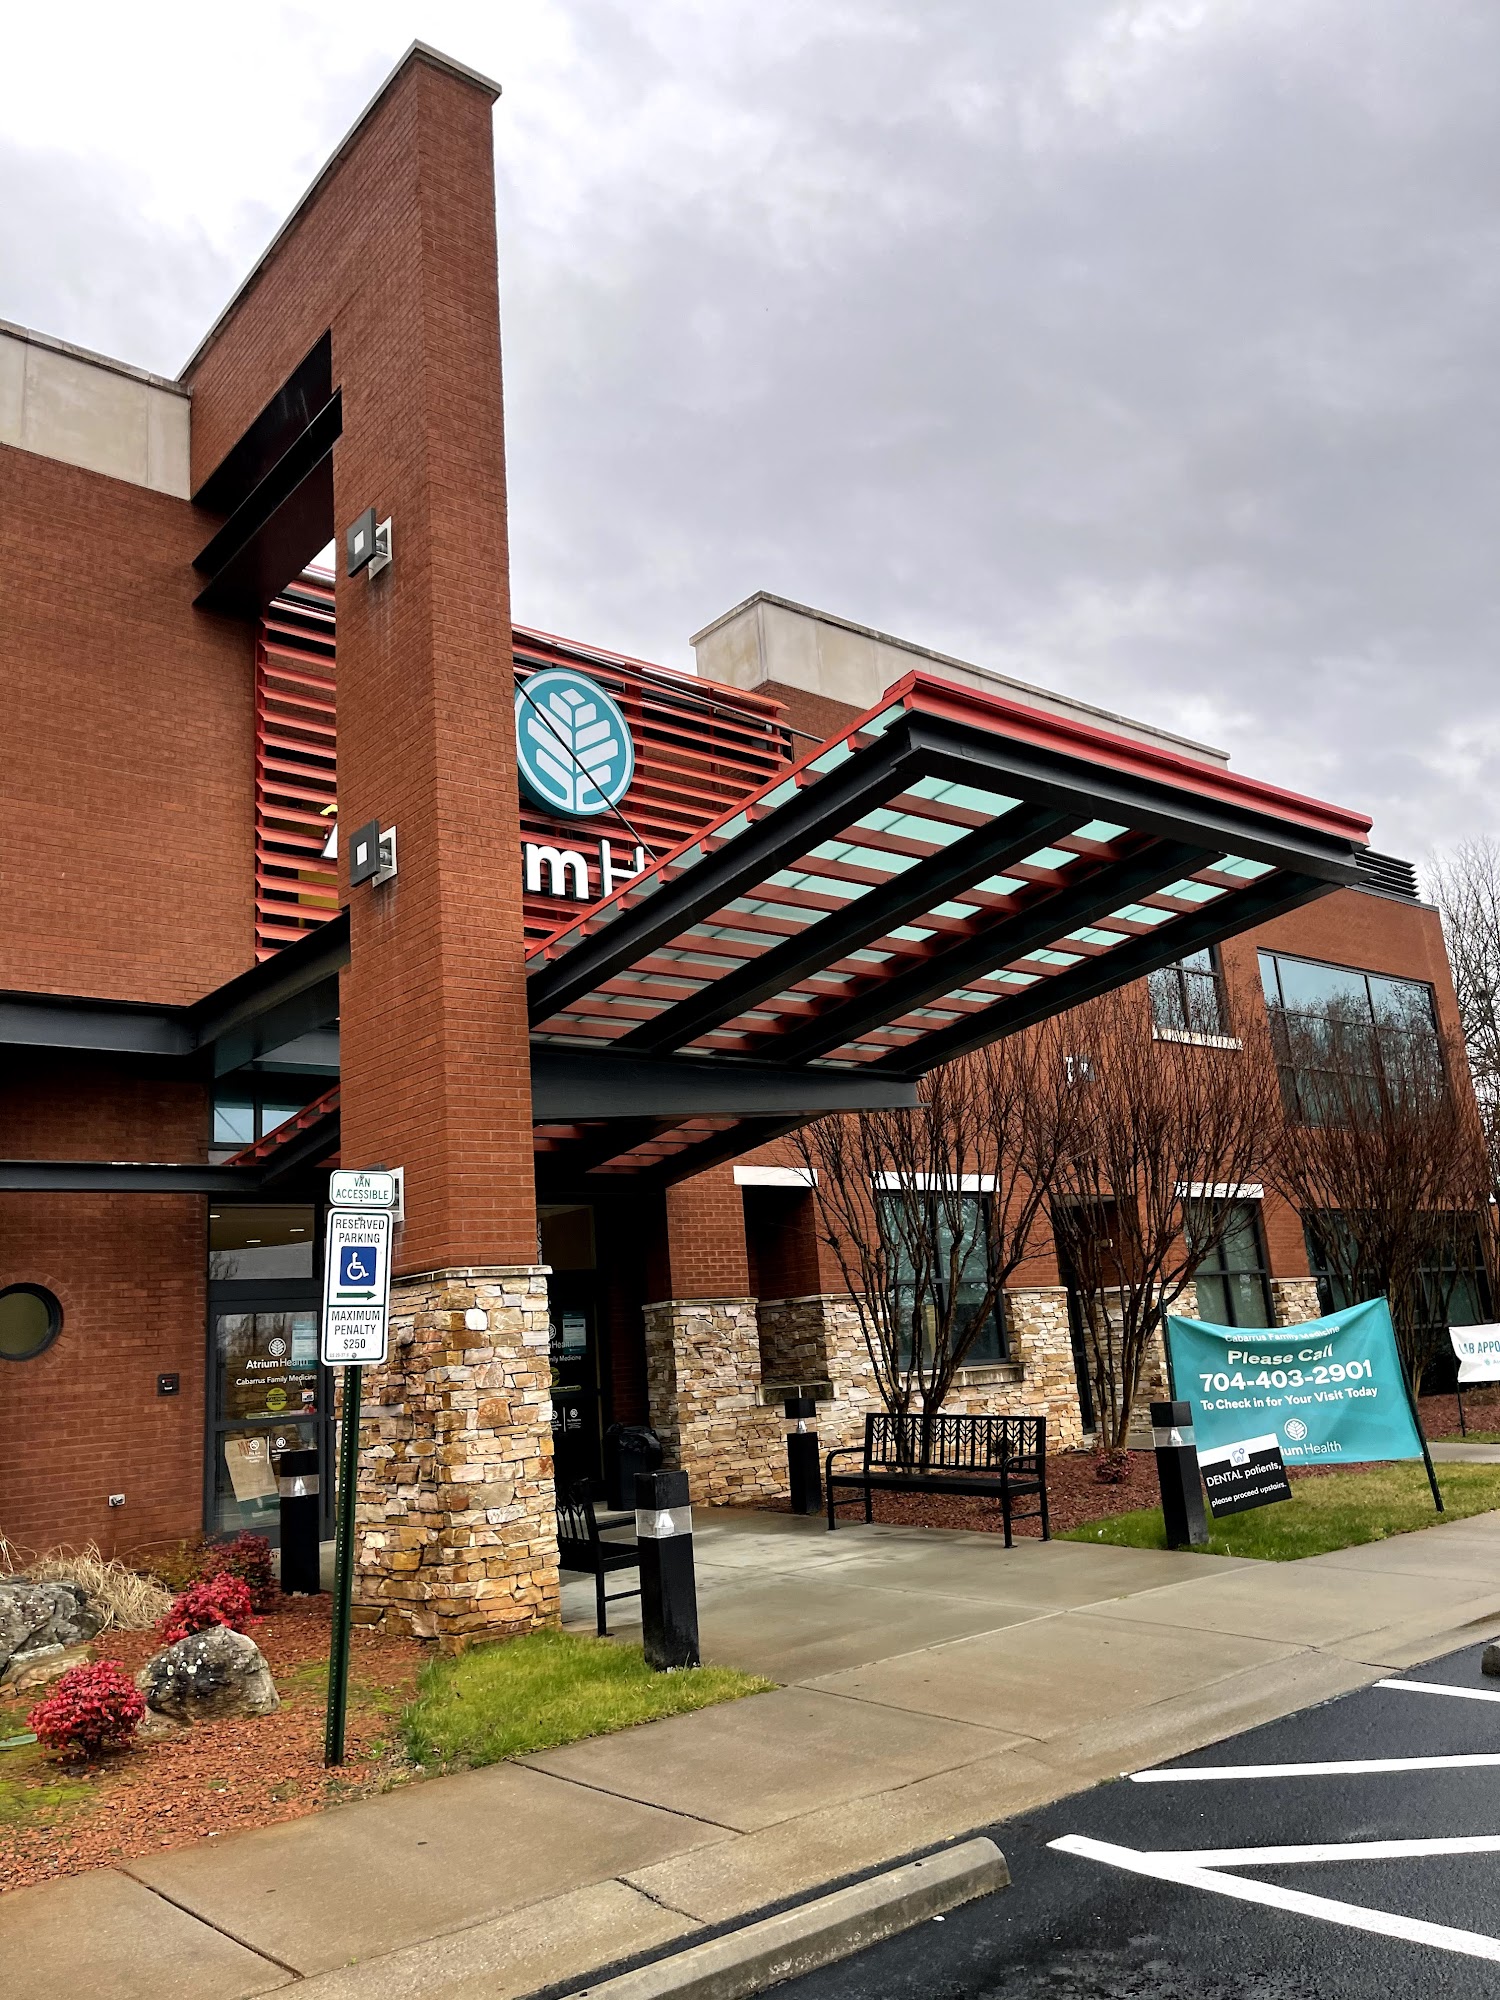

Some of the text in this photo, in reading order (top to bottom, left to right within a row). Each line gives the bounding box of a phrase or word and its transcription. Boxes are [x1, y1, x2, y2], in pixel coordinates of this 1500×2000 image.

[354, 1177, 371, 1188] VAN
[335, 1188, 389, 1200] ACCESSIBLE
[335, 1218, 385, 1230] RESERVED
[338, 1232, 380, 1244] PARKING
[331, 1310, 380, 1321] MAXIMUM
[334, 1324, 376, 1335] PENALTY
[1225, 1334, 1267, 1343] Cabarrus
[1268, 1332, 1299, 1342] Family
[343, 1338, 366, 1350] $250
[1227, 1343, 1333, 1365] Please Call
[245, 1359, 279, 1369] Atrium
[235, 1373, 318, 1386] Cabarrus Family Medicine
[1199, 1359, 1373, 1393] 704-403-2901
[1200, 1386, 1378, 1411] To Check in for Your Visit Today
[1280, 1440, 1342, 1457] ium Health
[1206, 1461, 1282, 1488] DENTAL patients,
[1211, 1481, 1288, 1508] please proceed upstairs.
